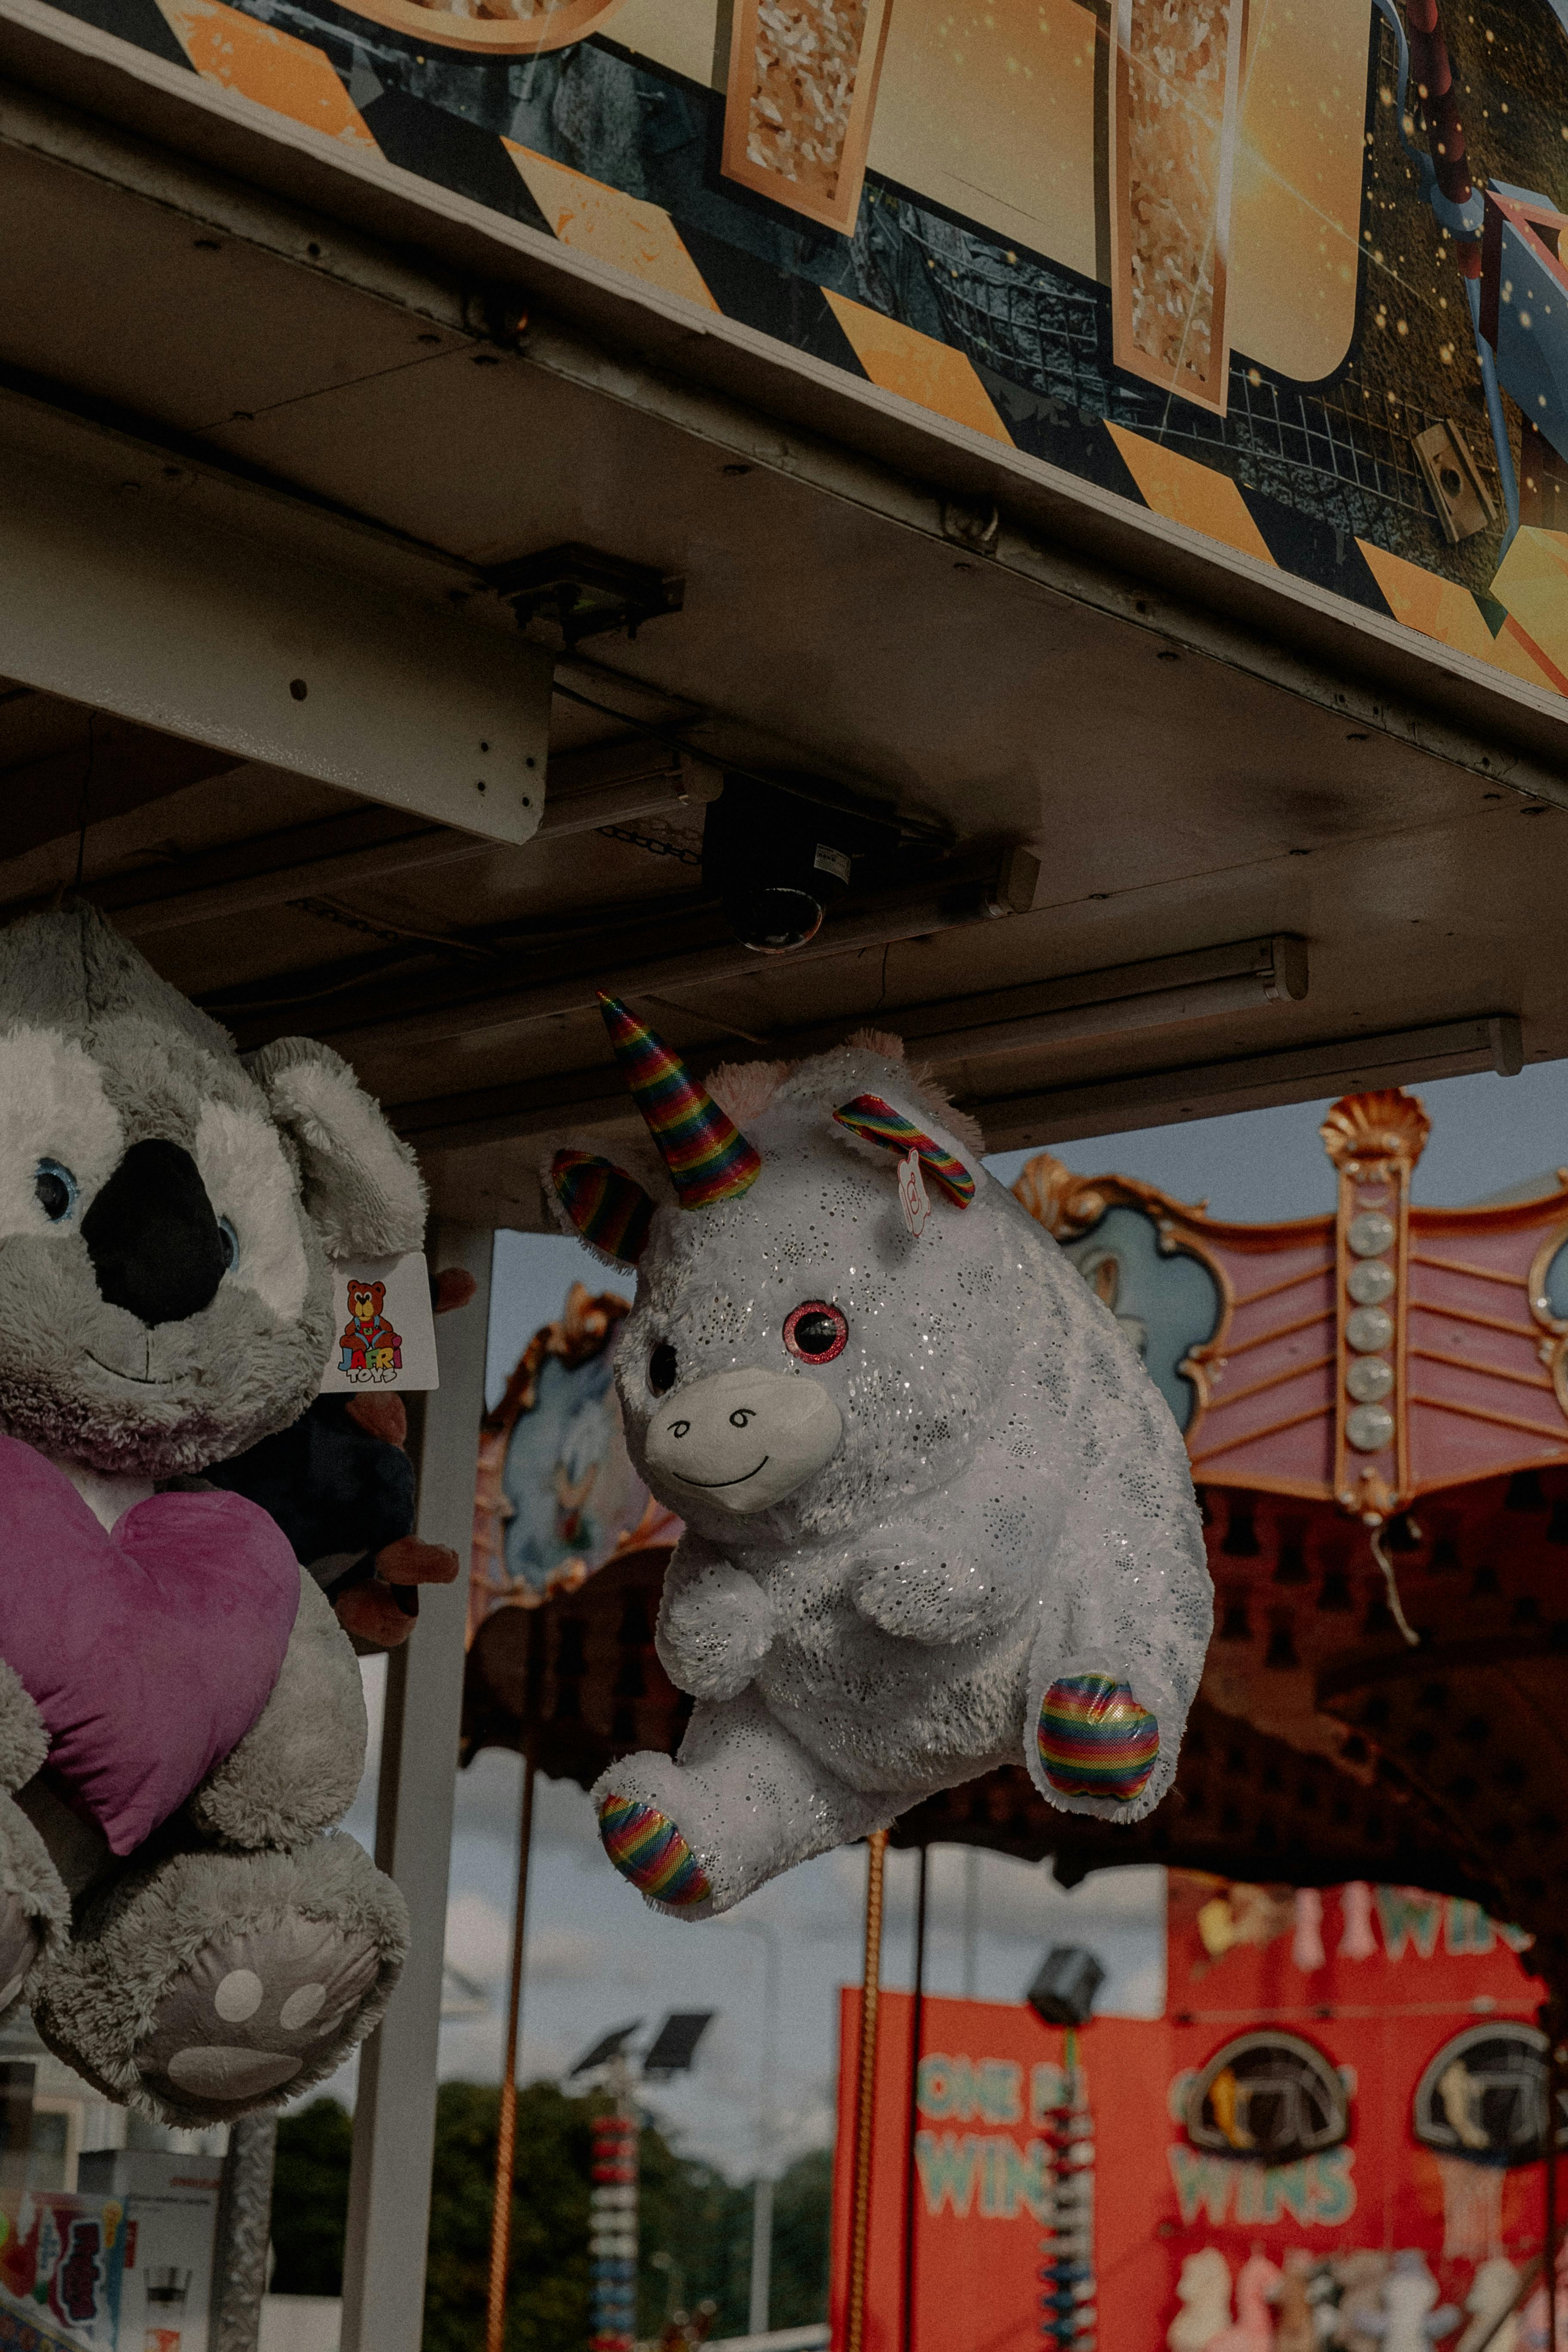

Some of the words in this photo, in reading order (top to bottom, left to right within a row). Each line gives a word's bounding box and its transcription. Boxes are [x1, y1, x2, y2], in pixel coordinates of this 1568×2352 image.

[338, 1335, 403, 1371] JAFRI
[346, 1367, 397, 1383] TOYS
[916, 2052, 1025, 2125] ONE
[1166, 2142, 1357, 2229] WINS
